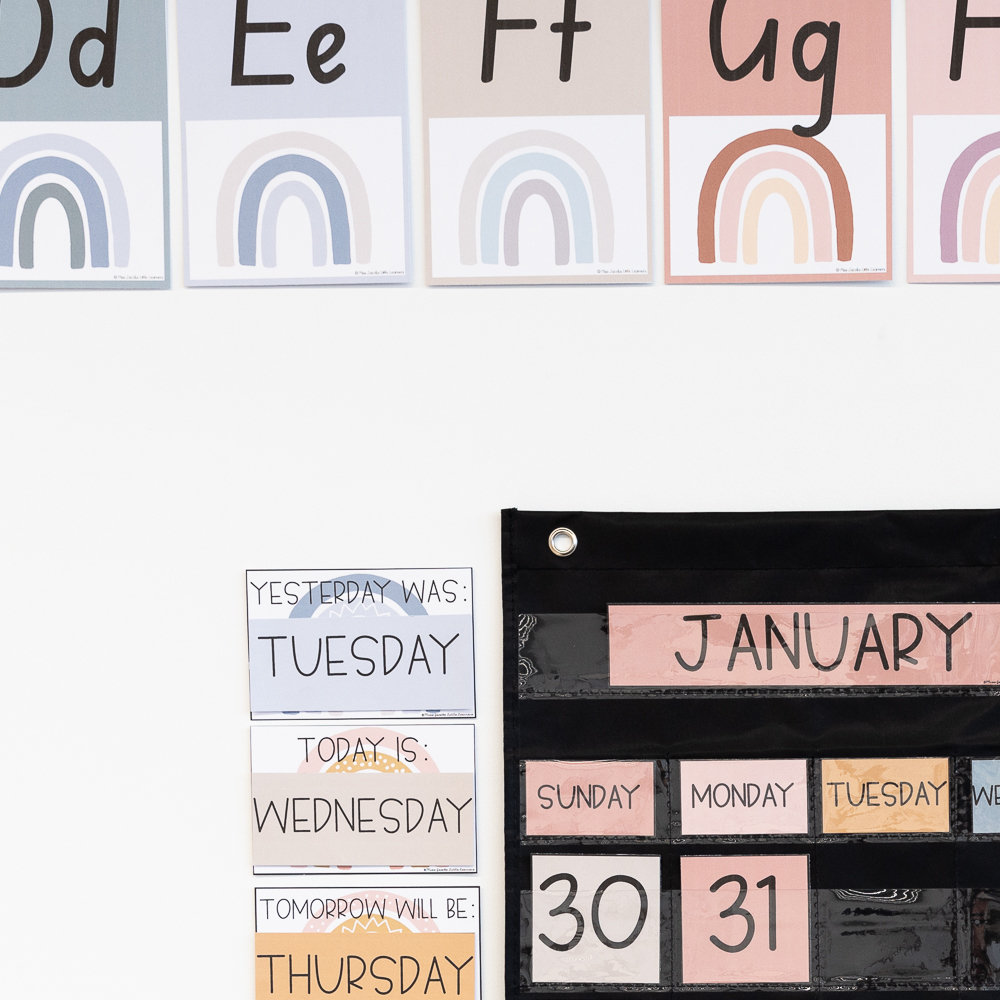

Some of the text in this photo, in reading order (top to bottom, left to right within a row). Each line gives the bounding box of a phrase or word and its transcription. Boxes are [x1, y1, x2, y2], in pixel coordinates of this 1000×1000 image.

[231, 0, 345, 86] Ee
[251, 580, 466, 605] YESTERDAY WAS:
[258, 633, 459, 677] TUESDAY
[675, 612, 972, 671] JANUARY
[298, 737, 427, 762] TODAY IS:
[538, 784, 640, 809] SUNDAY
[692, 783, 794, 808] MONDAY
[827, 781, 947, 807] TUESDAY
[254, 798, 472, 833] WEDNESDAY
[260, 898, 475, 919] TOMORROW WILL BE:
[539, 873, 648, 951] 30
[710, 875, 776, 953] 31
[257, 955, 473, 995] THURSDAY
